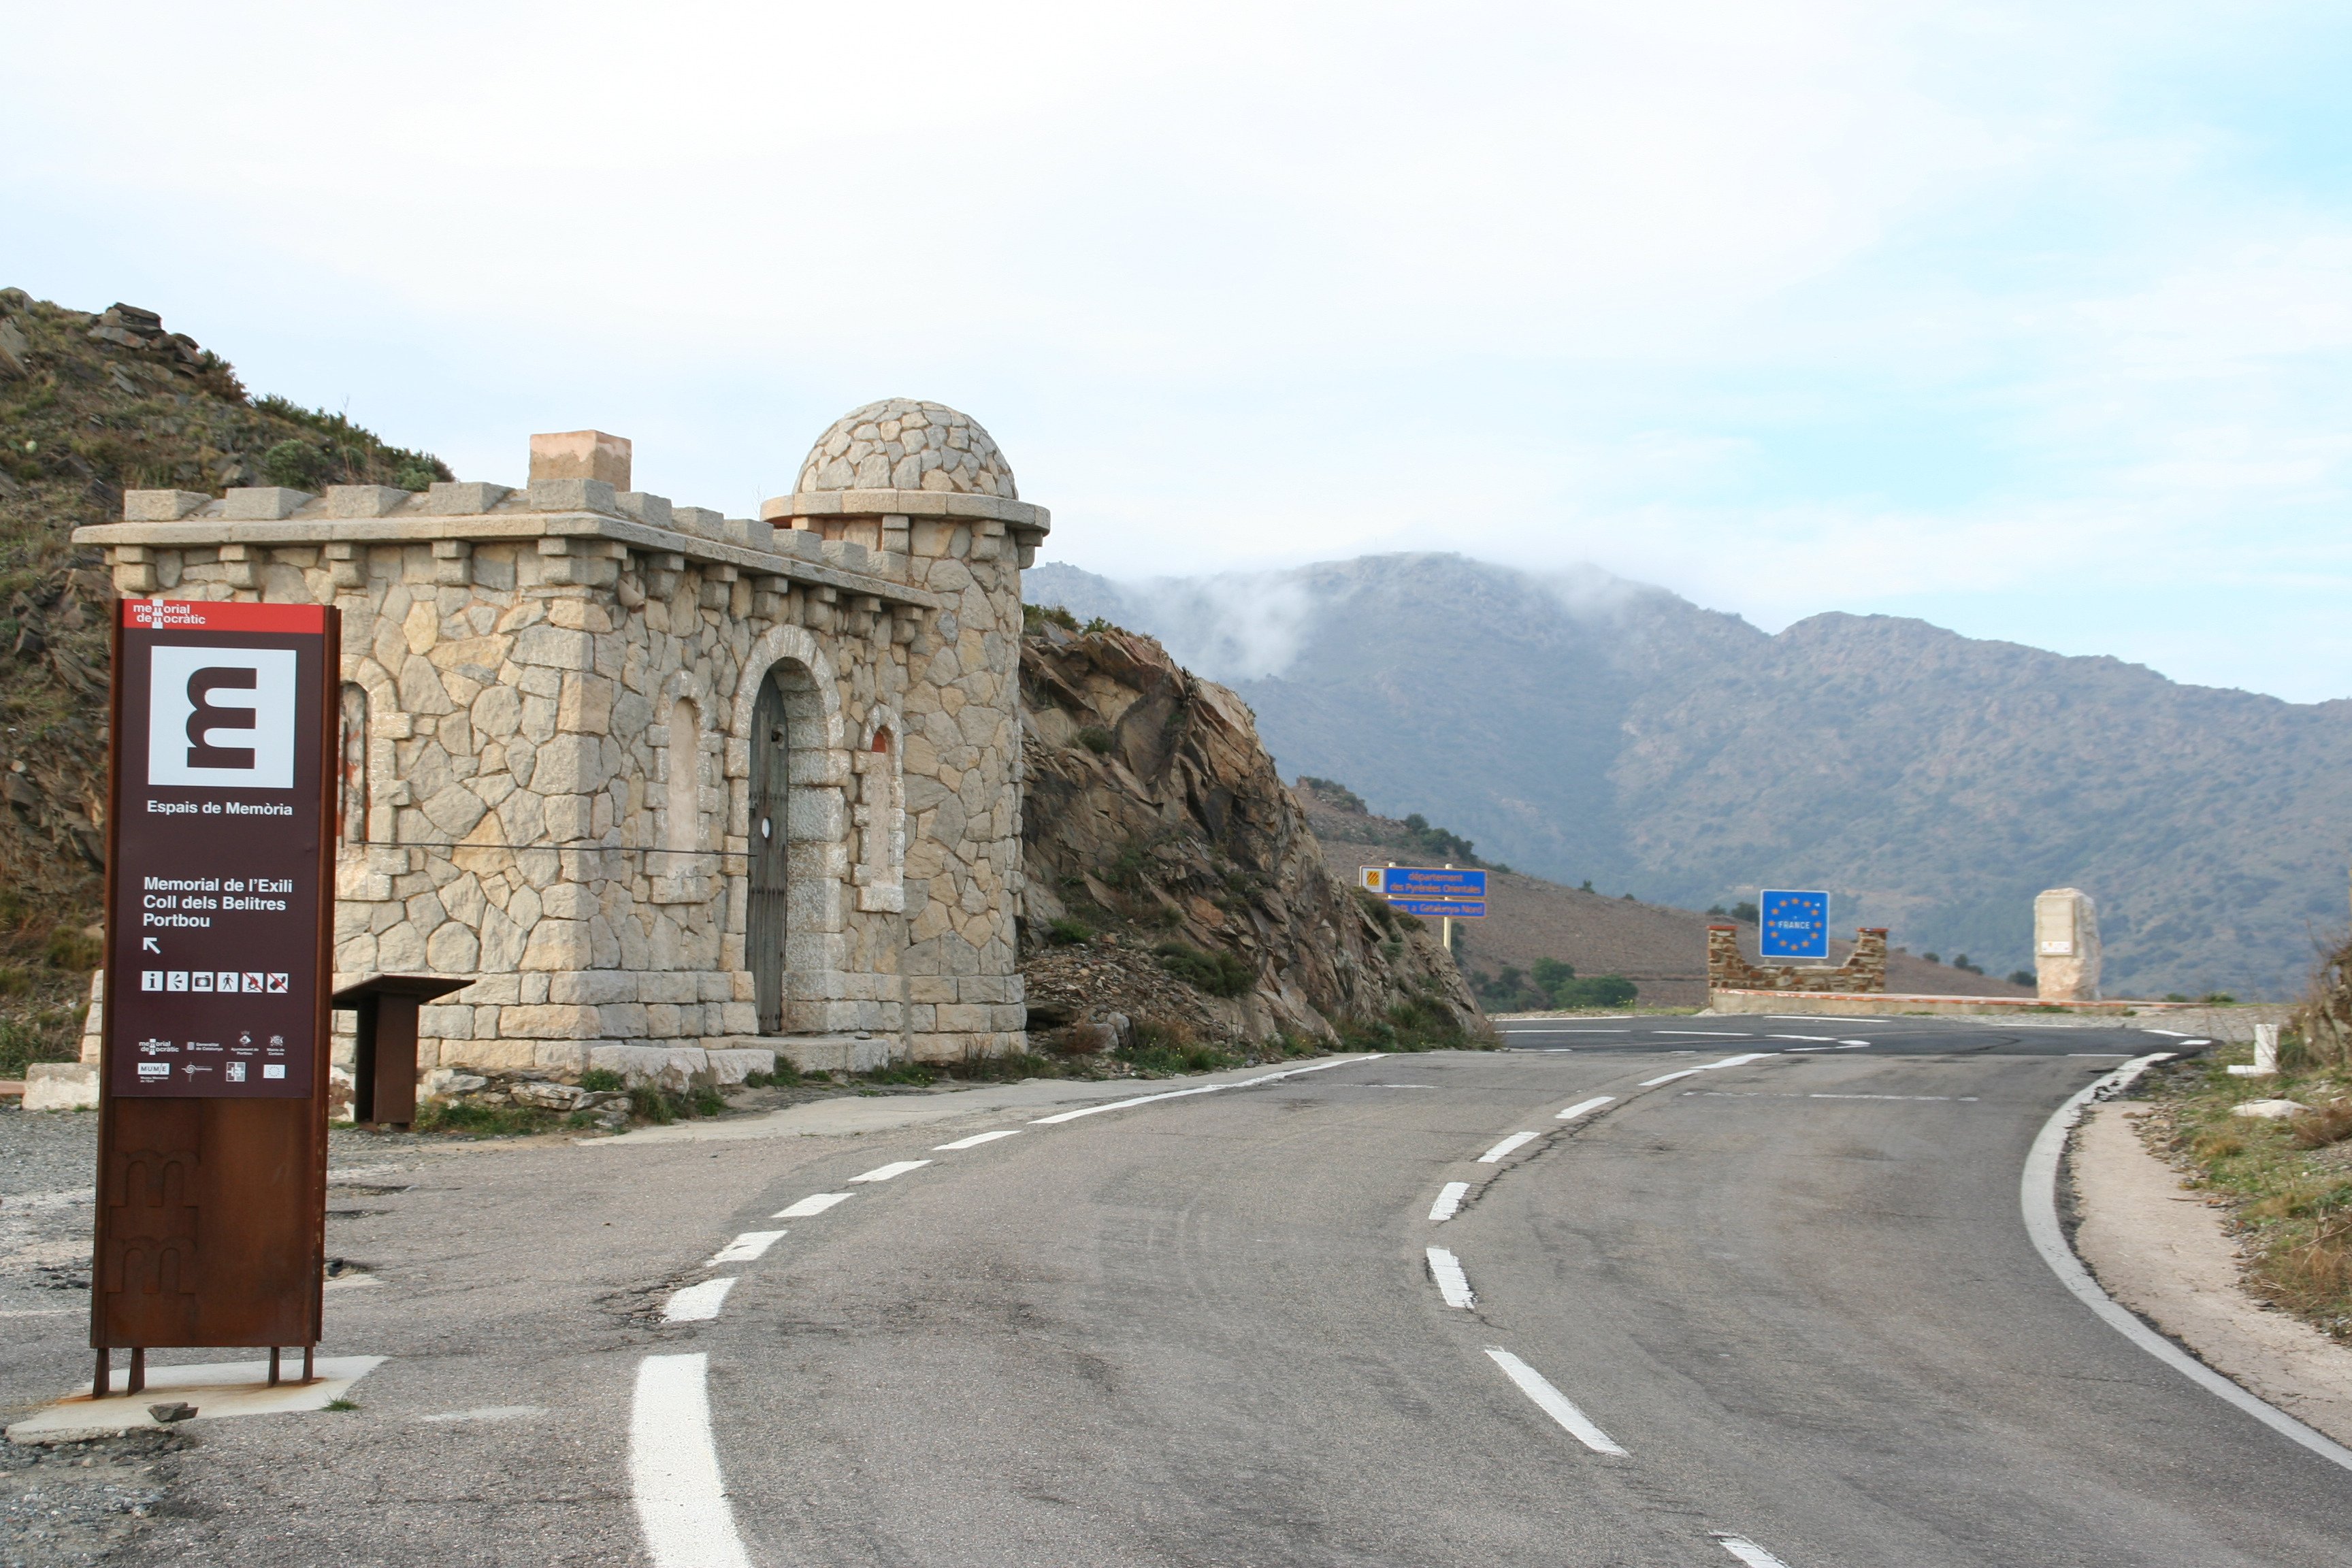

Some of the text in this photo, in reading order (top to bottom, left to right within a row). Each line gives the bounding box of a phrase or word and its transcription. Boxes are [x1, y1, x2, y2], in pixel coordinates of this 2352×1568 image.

[133, 604, 191, 614] memorial
[137, 613, 206, 625] democràtic
[147, 800, 293, 816] Espais de Memòria
[144, 877, 219, 892] Memorial
[224, 879, 244, 892] de
[143, 894, 287, 911] Coll dels Belitres
[143, 913, 211, 928] Portbou
[1778, 921, 1810, 930] FRANCE
